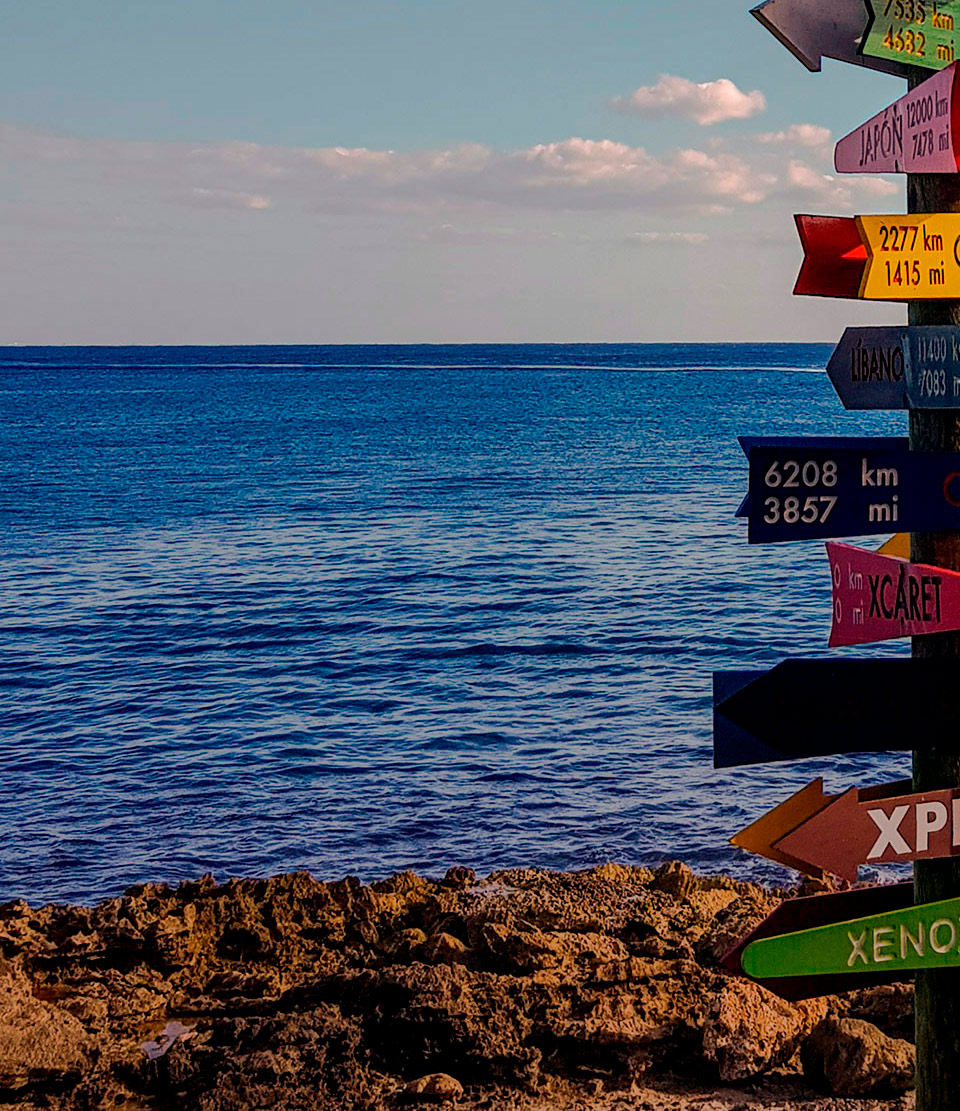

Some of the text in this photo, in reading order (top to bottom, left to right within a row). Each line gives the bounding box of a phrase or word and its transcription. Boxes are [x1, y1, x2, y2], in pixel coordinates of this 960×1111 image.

[932, 5, 954, 30] km
[883, 28, 954, 62] 4682 mi
[907, 93, 948, 129] 12000 km
[859, 104, 903, 166] JAPÓN
[912, 128, 949, 160] 7478 mi
[879, 224, 944, 252] 2277 km
[885, 260, 945, 287] 1415 mi
[851, 339, 904, 382] LÍBANO
[917, 336, 947, 363] 11400
[919, 369, 946, 396] 7083
[764, 459, 898, 488] 6208 km
[763, 496, 898, 524] 3857 mi
[848, 565, 863, 590] km
[868, 572, 942, 624] XCARET
[852, 600, 864, 625] mi
